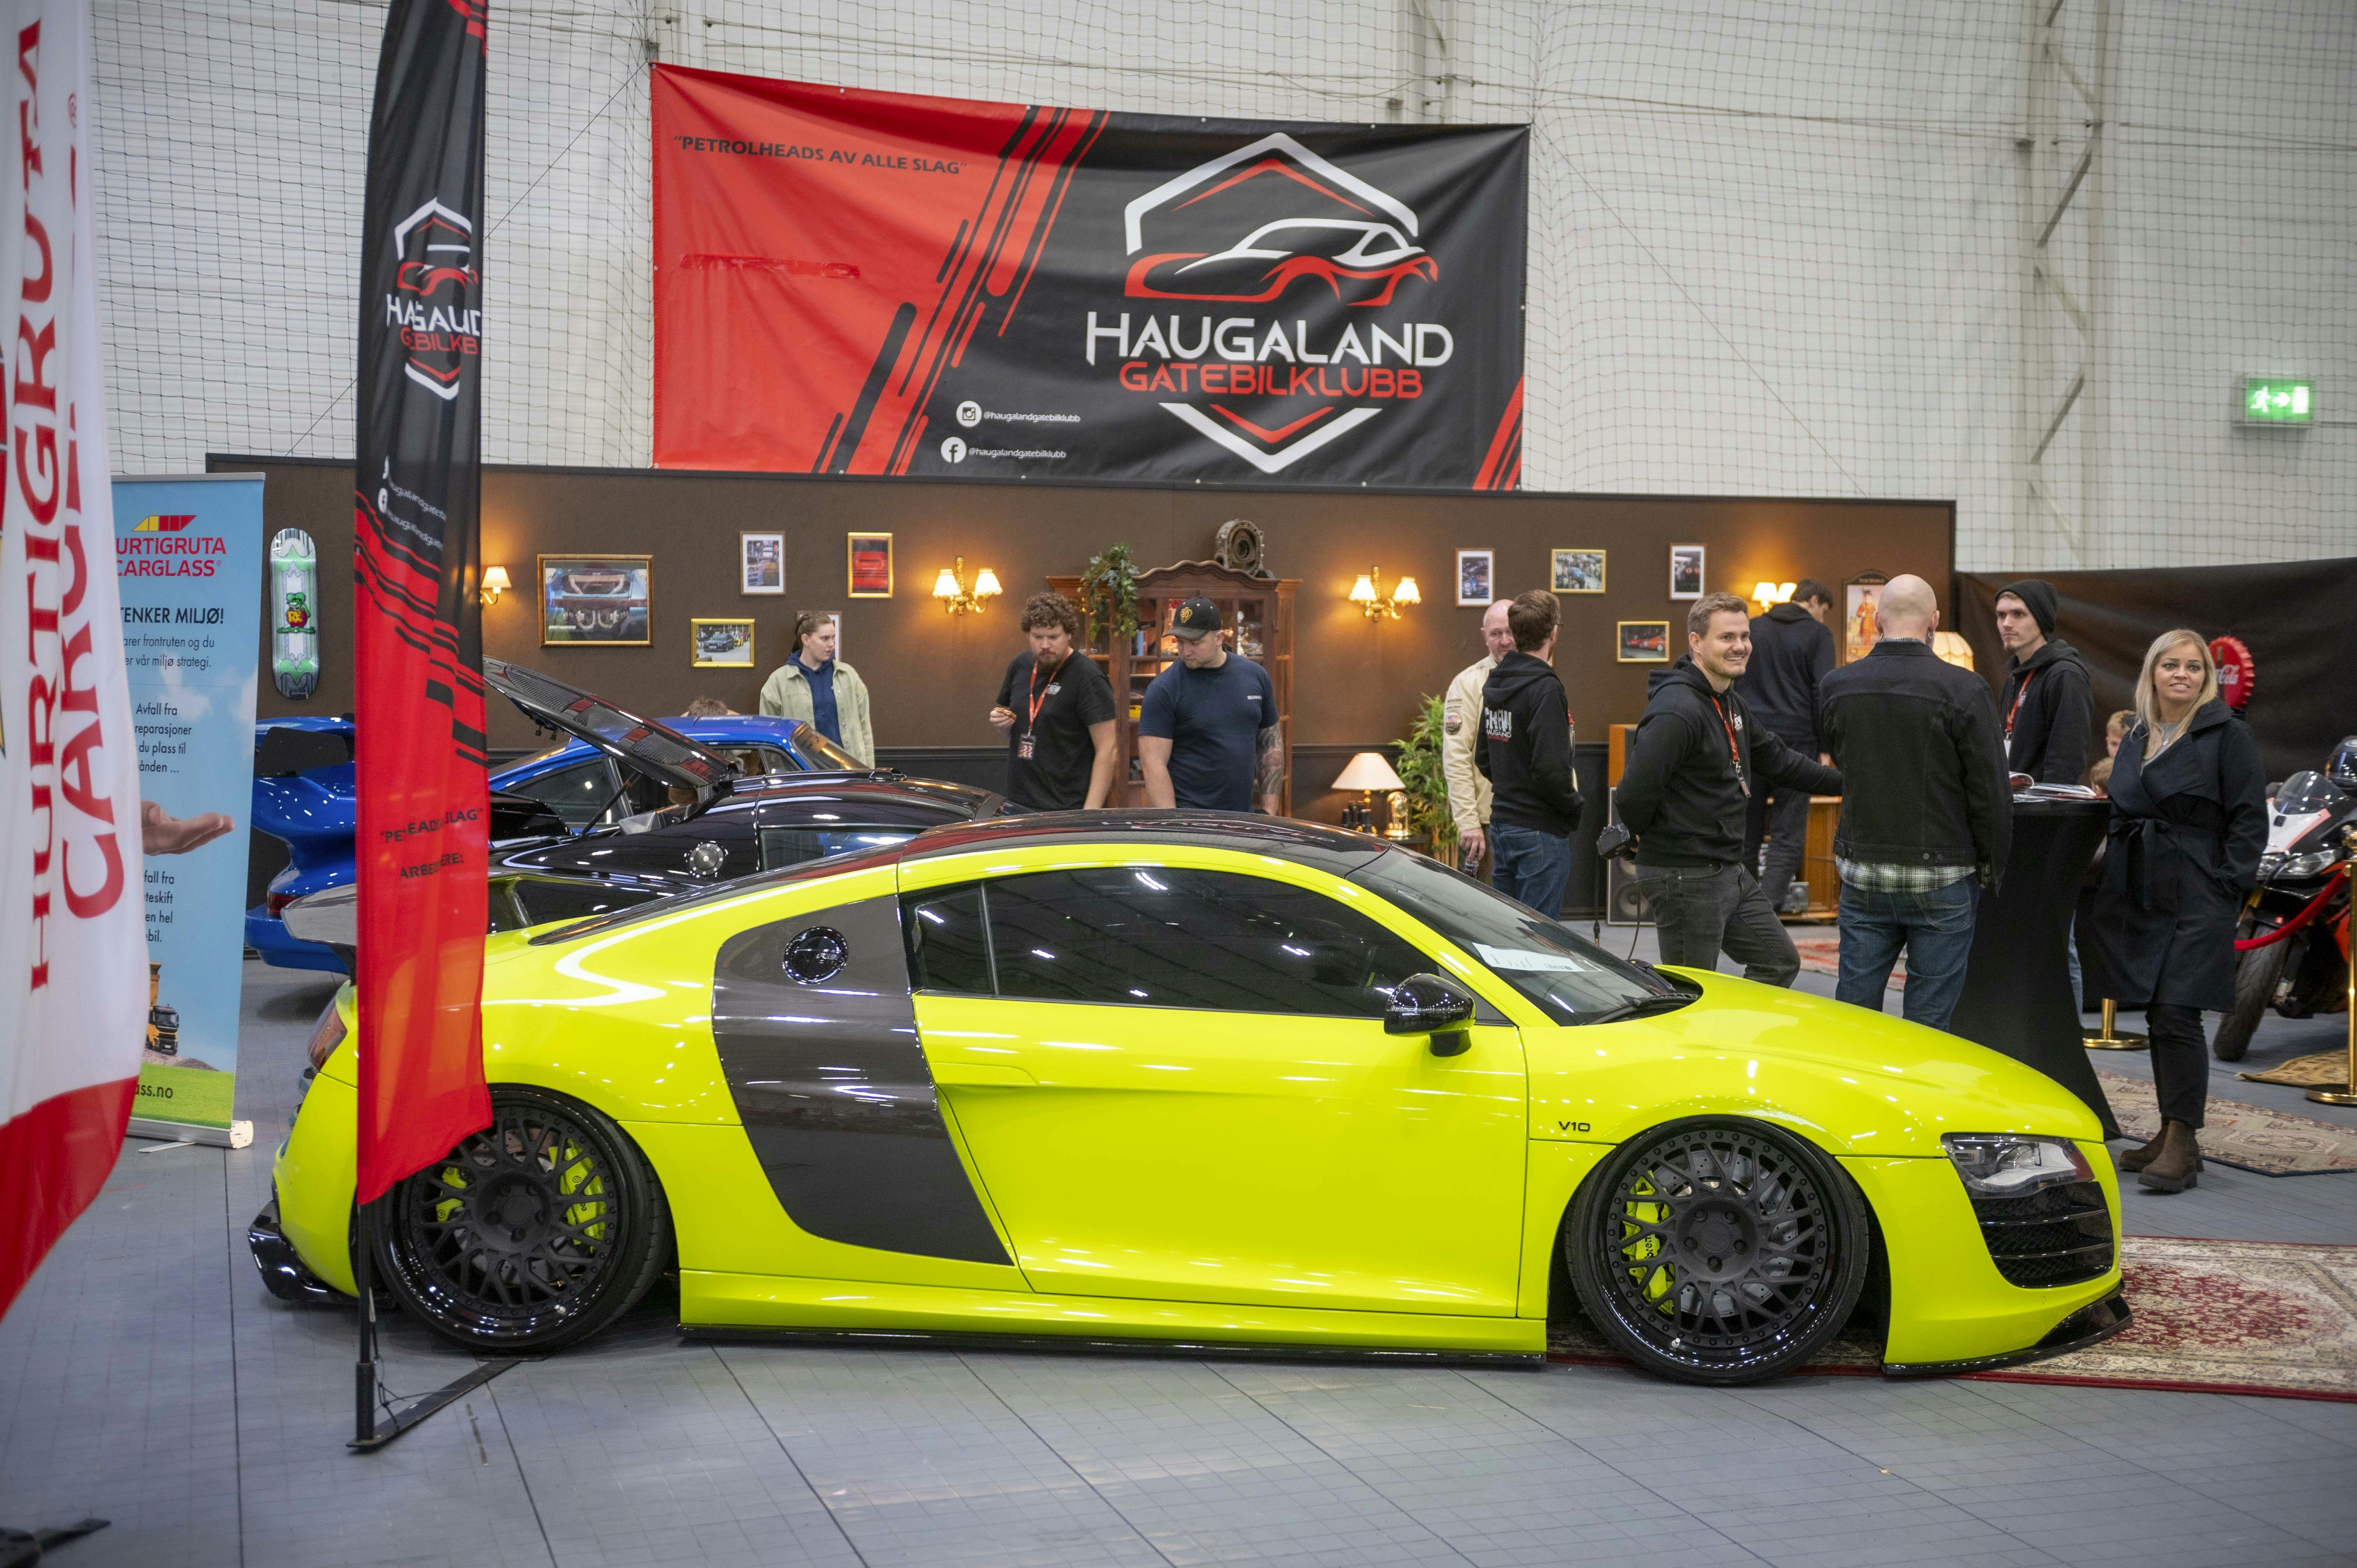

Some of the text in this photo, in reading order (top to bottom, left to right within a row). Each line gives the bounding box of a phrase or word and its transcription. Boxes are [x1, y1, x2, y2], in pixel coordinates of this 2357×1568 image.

[829, 150, 857, 164] AV
[861, 154, 907, 170] ALLE
[1086, 311, 1454, 367] HAUGALAND
[1120, 362, 1423, 398] GATEBILKLUBB
[983, 411, 1081, 422] @haugalandgatebilklubb
[968, 447, 1067, 459] @haugalandgatebilklubb
[116, 537, 226, 554] URTIGRUTA
[121, 607, 224, 624] ENKER MILJØ!
[143, 634, 185, 647] frontruten
[188, 639, 199, 650] og
[203, 635, 214, 648] du
[136, 655, 150, 666] vår
[152, 654, 174, 669] miljø
[177, 656, 211, 670] strategi.
[136, 703, 177, 715] Avfall fra
[135, 723, 192, 738] reparasjoner
[139, 740, 149, 752] du
[152, 741, 176, 756] plass
[139, 760, 167, 772] ånden
[162, 871, 174, 884] fra
[144, 891, 173, 904] teskift
[145, 910, 173, 923] en hel
[146, 929, 162, 942] bil.
[1558, 1121, 1591, 1132] V10
